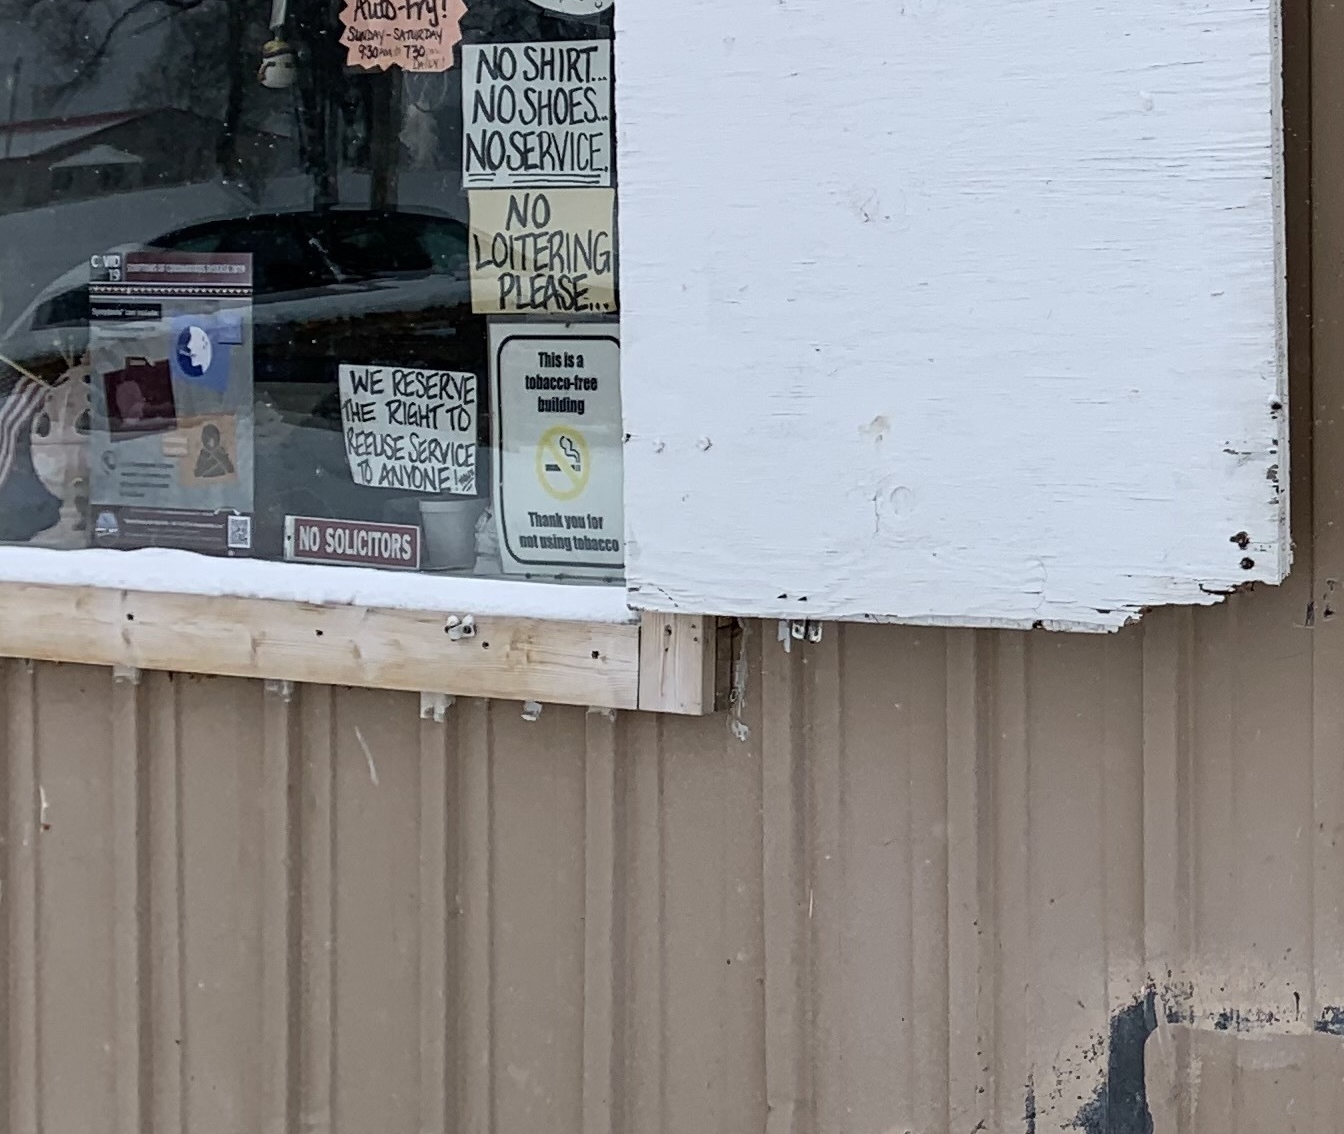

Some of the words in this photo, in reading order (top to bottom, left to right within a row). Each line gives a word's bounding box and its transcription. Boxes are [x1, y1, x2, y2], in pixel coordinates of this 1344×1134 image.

[476, 46, 517, 84] NO
[472, 85, 516, 125] NO
[465, 129, 507, 172] NO
[507, 131, 609, 172] SERVICE.
[506, 193, 550, 231] NO
[473, 230, 610, 275] LOITERING
[538, 351, 561, 369] This
[564, 351, 574, 368] is
[577, 355, 584, 368] a
[350, 369, 384, 395] WE
[392, 369, 475, 405] RESERVE
[525, 374, 598, 391] tobacco-free
[341, 398, 376, 422] THE
[385, 399, 445, 429] RIGHT
[446, 404, 471, 431] TO
[538, 396, 585, 414] building
[408, 432, 475, 467] SERVICE
[357, 459, 372, 484] TO
[528, 511, 562, 529] Thank
[564, 516, 585, 531] you
[587, 515, 603, 530] for
[300, 525, 321, 552] NO
[325, 527, 412, 560] SOLICITORS
[574, 535, 619, 552] tobacco
